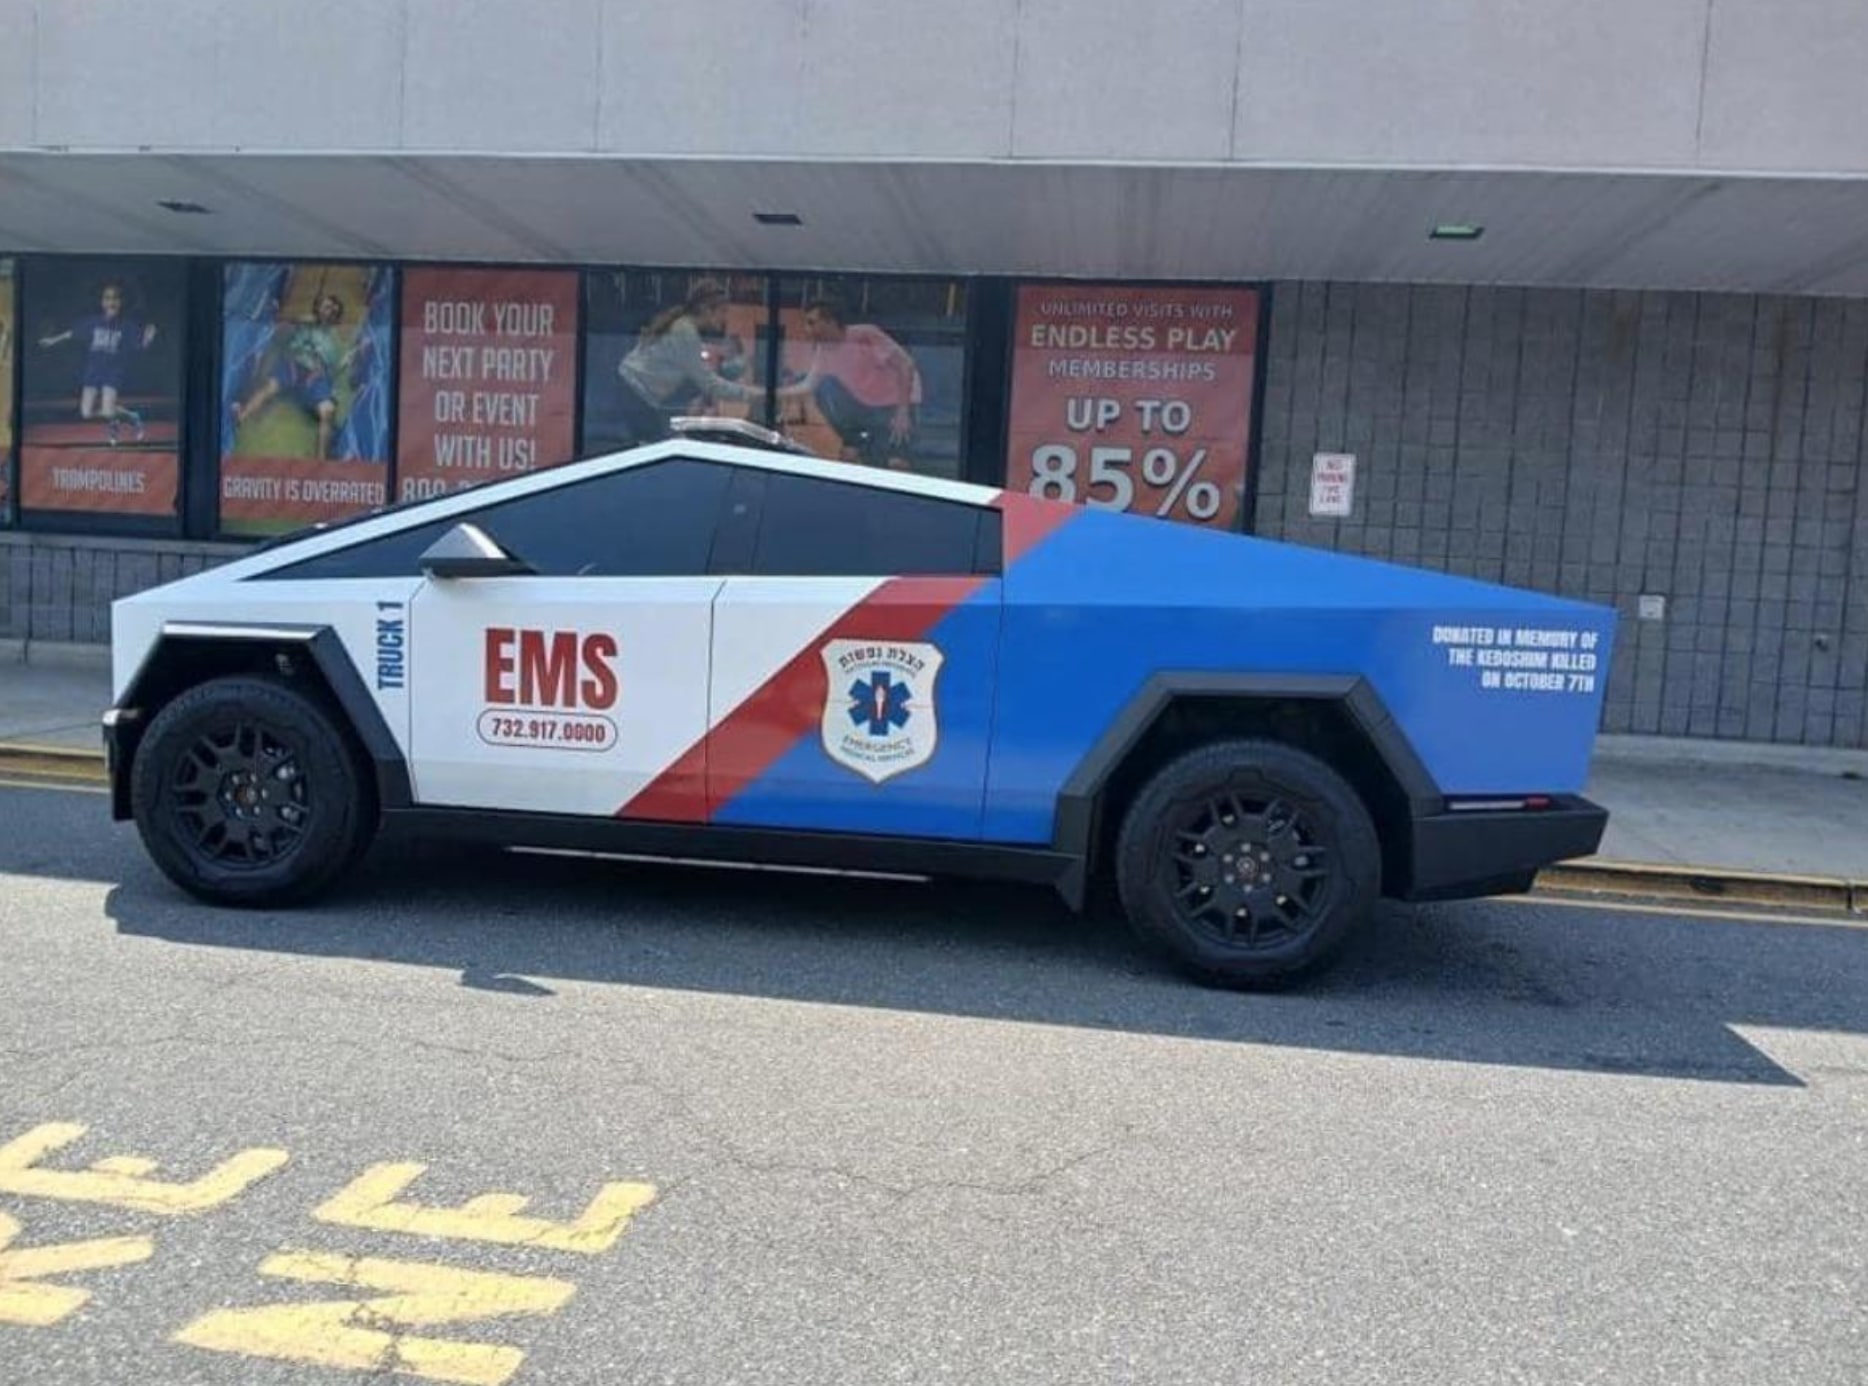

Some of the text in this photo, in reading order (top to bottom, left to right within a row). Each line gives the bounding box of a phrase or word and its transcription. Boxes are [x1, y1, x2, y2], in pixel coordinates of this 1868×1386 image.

[424, 302, 555, 337] BOOK YOUR
[1040, 302, 1233, 319] UNLIMITED VISITS WITH
[1030, 324, 1238, 353] ENDLESS PLAY
[422, 346, 555, 382] NEXT PARTY
[1048, 358, 1217, 381] MEMBERSHIPS
[434, 390, 540, 427] OR EVENT
[1065, 397, 1193, 433] UP TO
[433, 433, 537, 471] WITH US!
[51, 466, 147, 494] TRAMPOLINES
[223, 476, 385, 506] GRAVITY IS OVERRATED
[1028, 443, 1222, 520] 85%
[377, 600, 405, 691] TRUCK 1
[1432, 625, 1599, 650] DONATED IN MEMORY OF
[484, 627, 619, 711] EMS
[1449, 648, 1474, 666] THE
[1550, 652, 1597, 672] KILLED
[1481, 670, 1596, 694] ON OCTOBER 7TH
[491, 717, 606, 744] 732.917.0000
